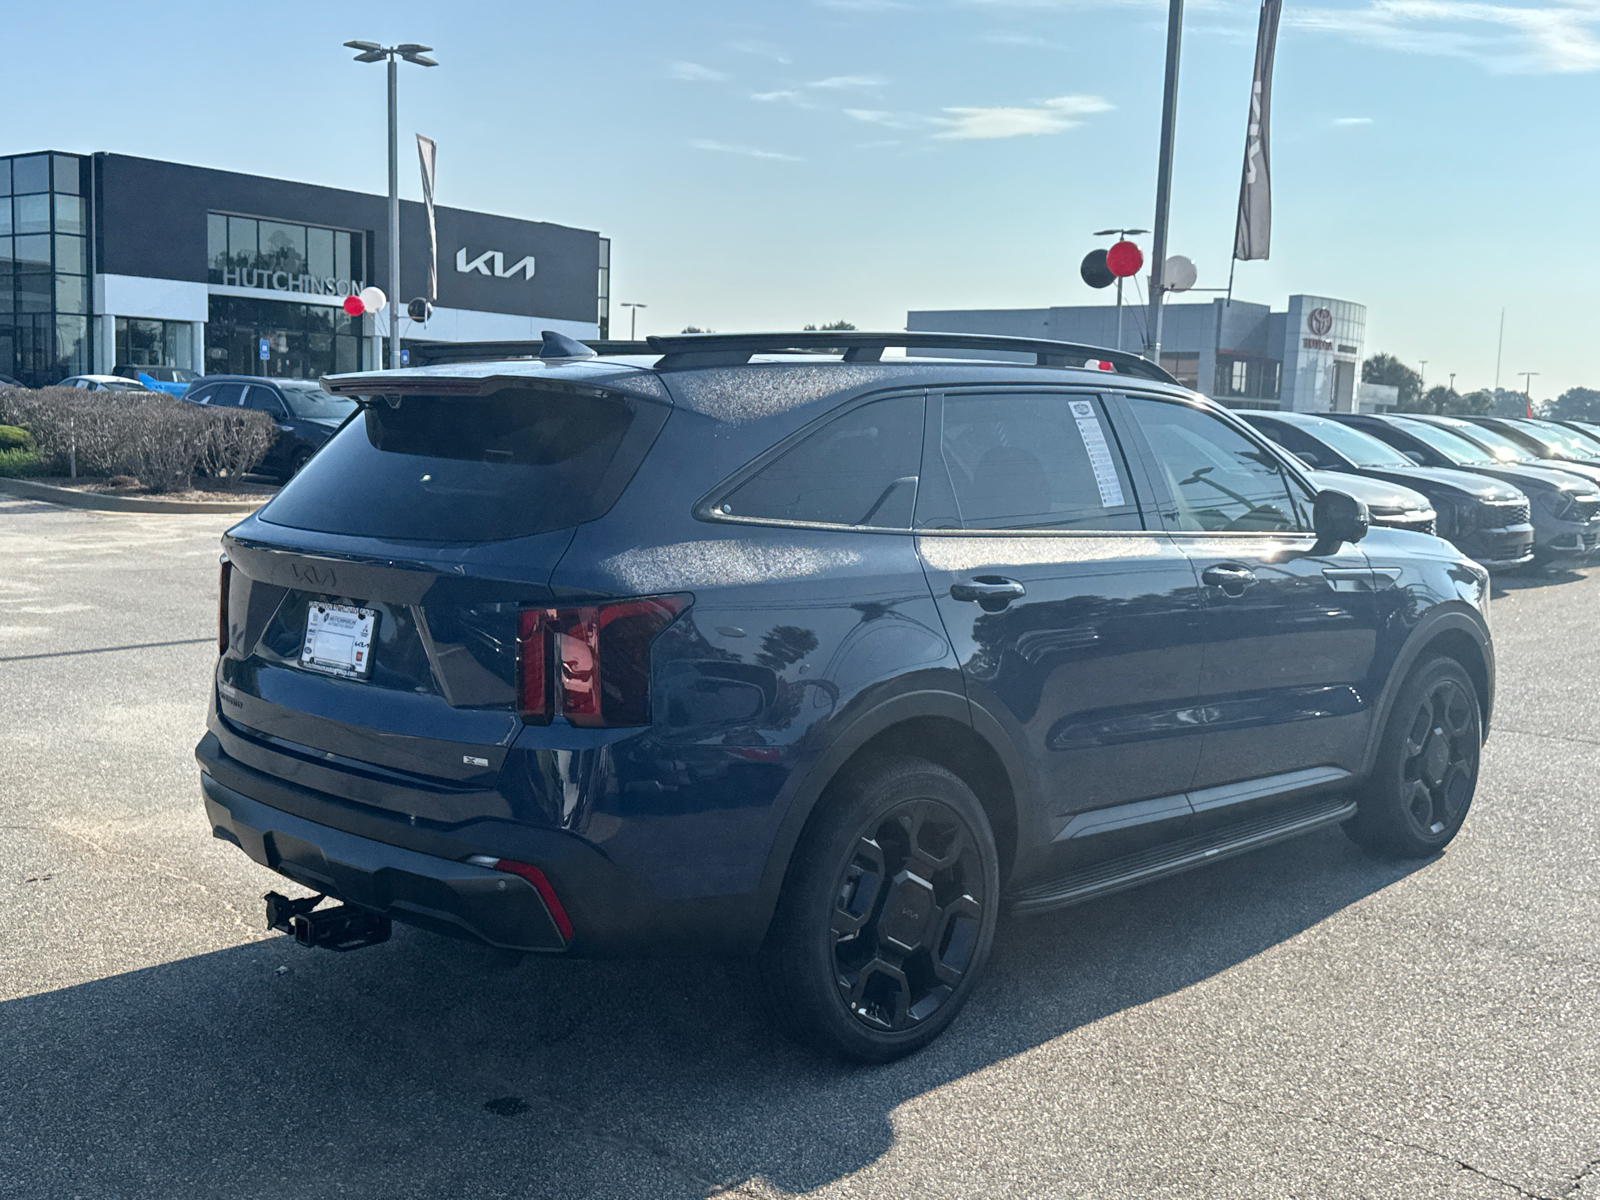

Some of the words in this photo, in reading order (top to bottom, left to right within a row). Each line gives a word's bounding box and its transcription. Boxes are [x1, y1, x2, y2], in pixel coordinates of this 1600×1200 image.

[455, 246, 536, 281] KIA
[222, 266, 364, 297] HUTCHINSON
[291, 563, 337, 587] KIA
